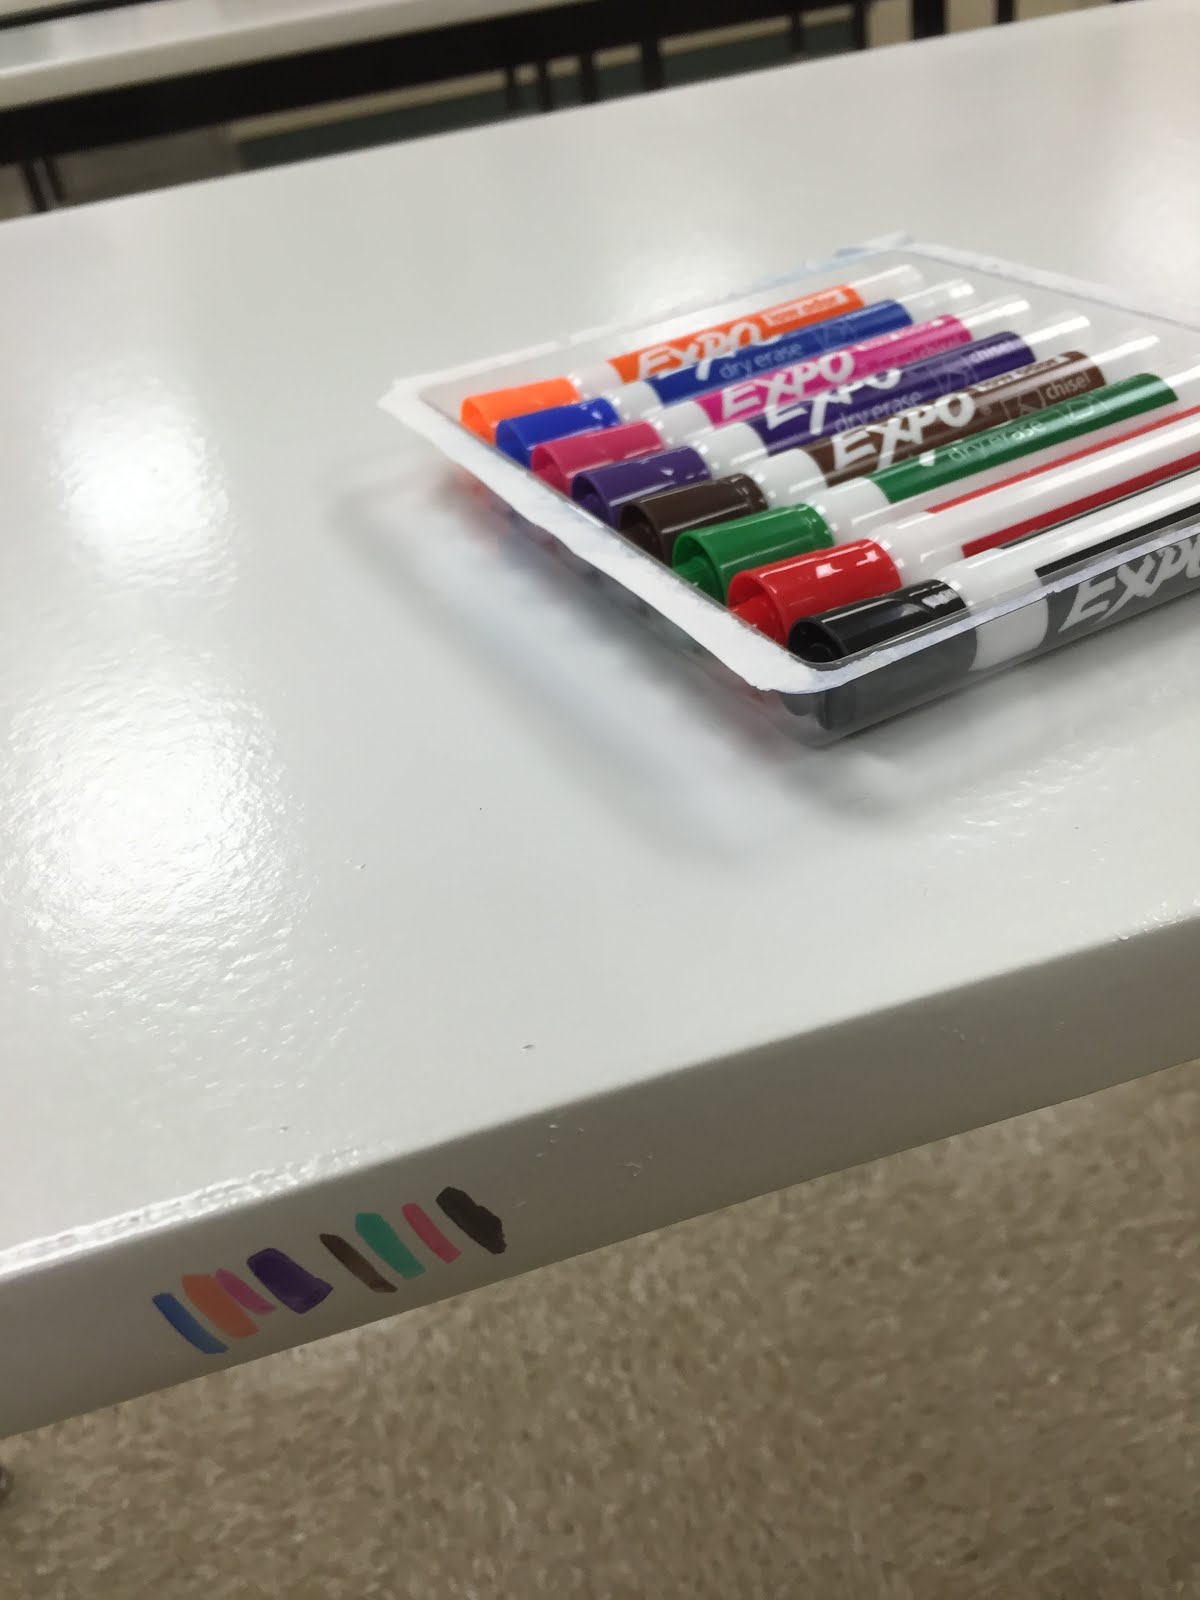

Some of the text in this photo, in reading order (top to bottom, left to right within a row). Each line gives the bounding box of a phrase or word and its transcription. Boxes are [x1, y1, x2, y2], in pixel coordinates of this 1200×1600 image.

[638, 321, 762, 380] EXPO
[721, 350, 855, 420] EXPO
[1045, 371, 1092, 400] chisel
[831, 392, 976, 471] EXPO
